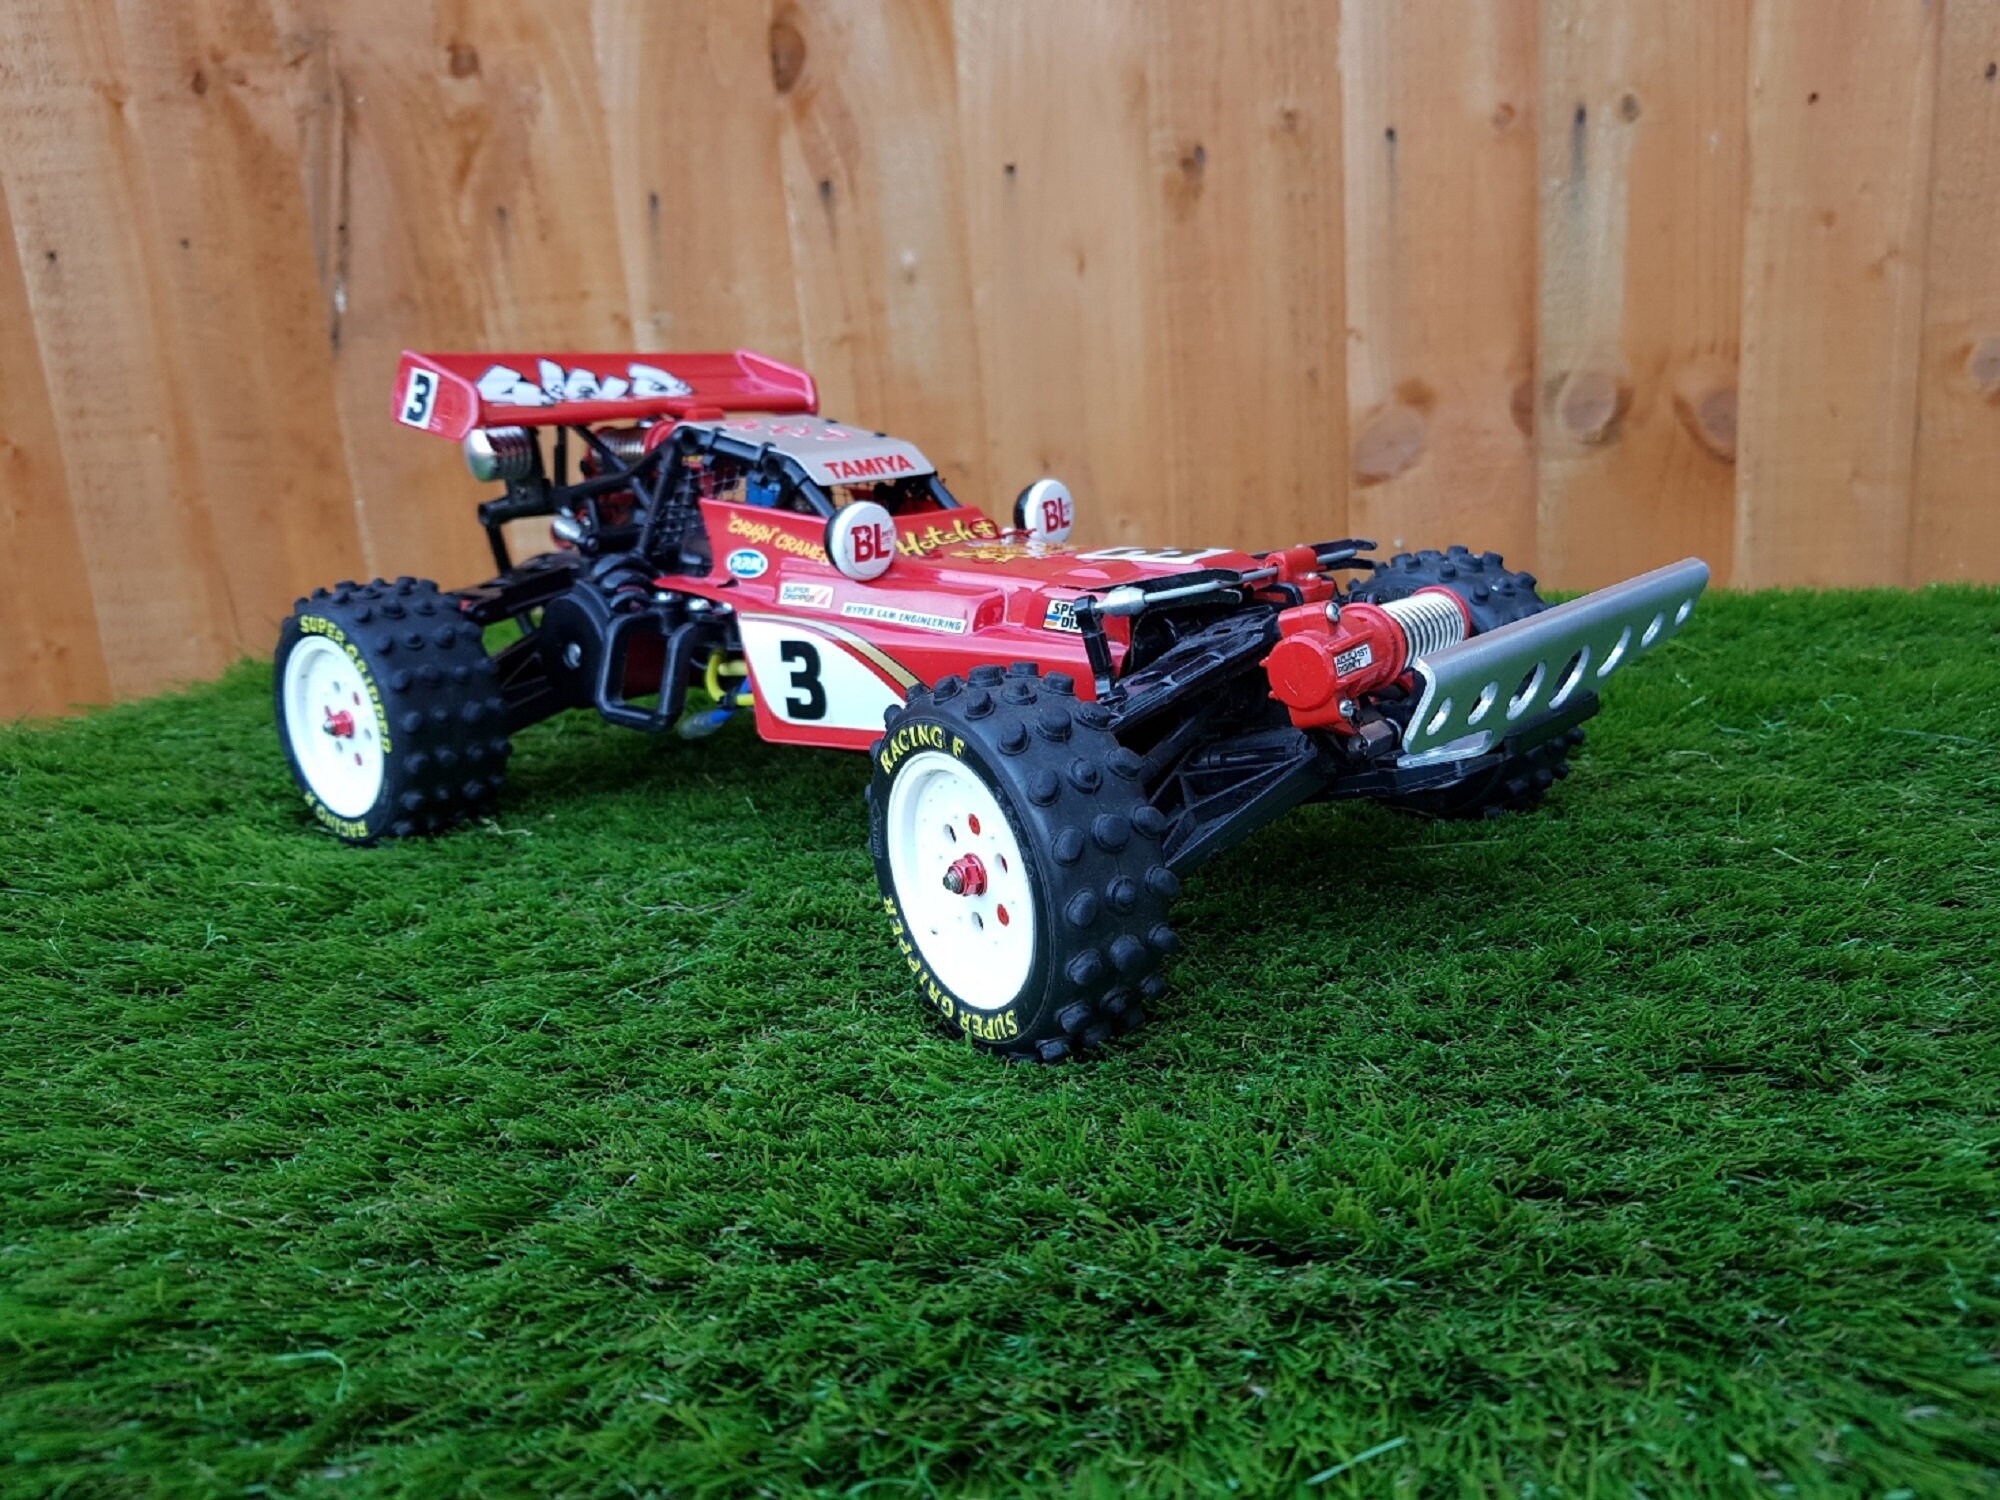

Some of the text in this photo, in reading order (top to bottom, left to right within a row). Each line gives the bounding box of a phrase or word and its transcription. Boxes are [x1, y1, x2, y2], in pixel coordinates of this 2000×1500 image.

[406, 373, 431, 422] 3
[824, 454, 915, 480] TAMIYA
[1041, 497, 1070, 534] BL
[850, 523, 891, 563] BL
[785, 585, 811, 594] SUPER
[899, 613, 963, 632] ENGINEERING
[1052, 603, 1076, 617] SPE
[300, 614, 345, 645] SUPER
[780, 640, 827, 721] 3
[880, 724, 965, 774] RACING F
[959, 1009, 1018, 1041] SUPER
